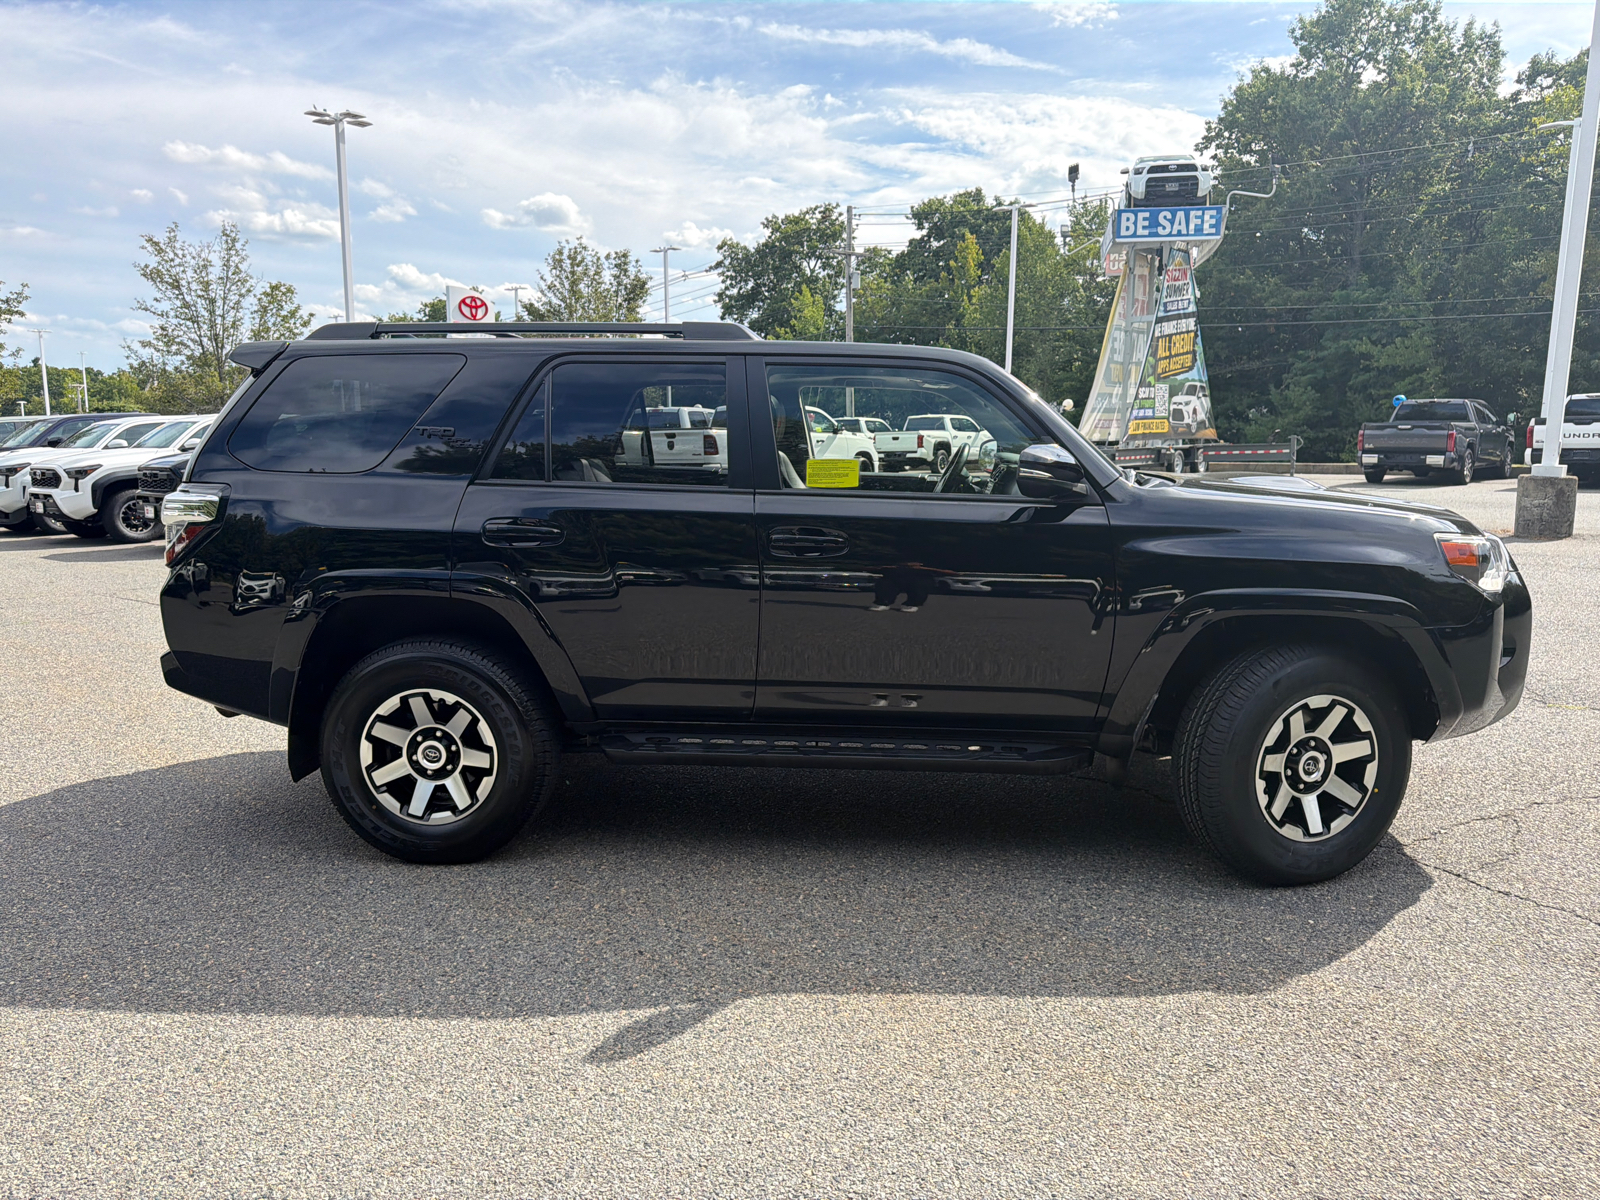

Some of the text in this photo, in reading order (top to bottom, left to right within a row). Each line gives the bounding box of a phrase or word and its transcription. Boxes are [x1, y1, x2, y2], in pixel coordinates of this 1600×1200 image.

[1120, 210, 1217, 236] BE SAFE
[1164, 282, 1190, 299] SUMMER
[1158, 337, 1170, 359] ALL
[1171, 332, 1194, 356] CREDIT
[1158, 359, 1169, 374] APPS
[415, 426, 455, 439] TRD
[1141, 421, 1154, 431] FINANCE
